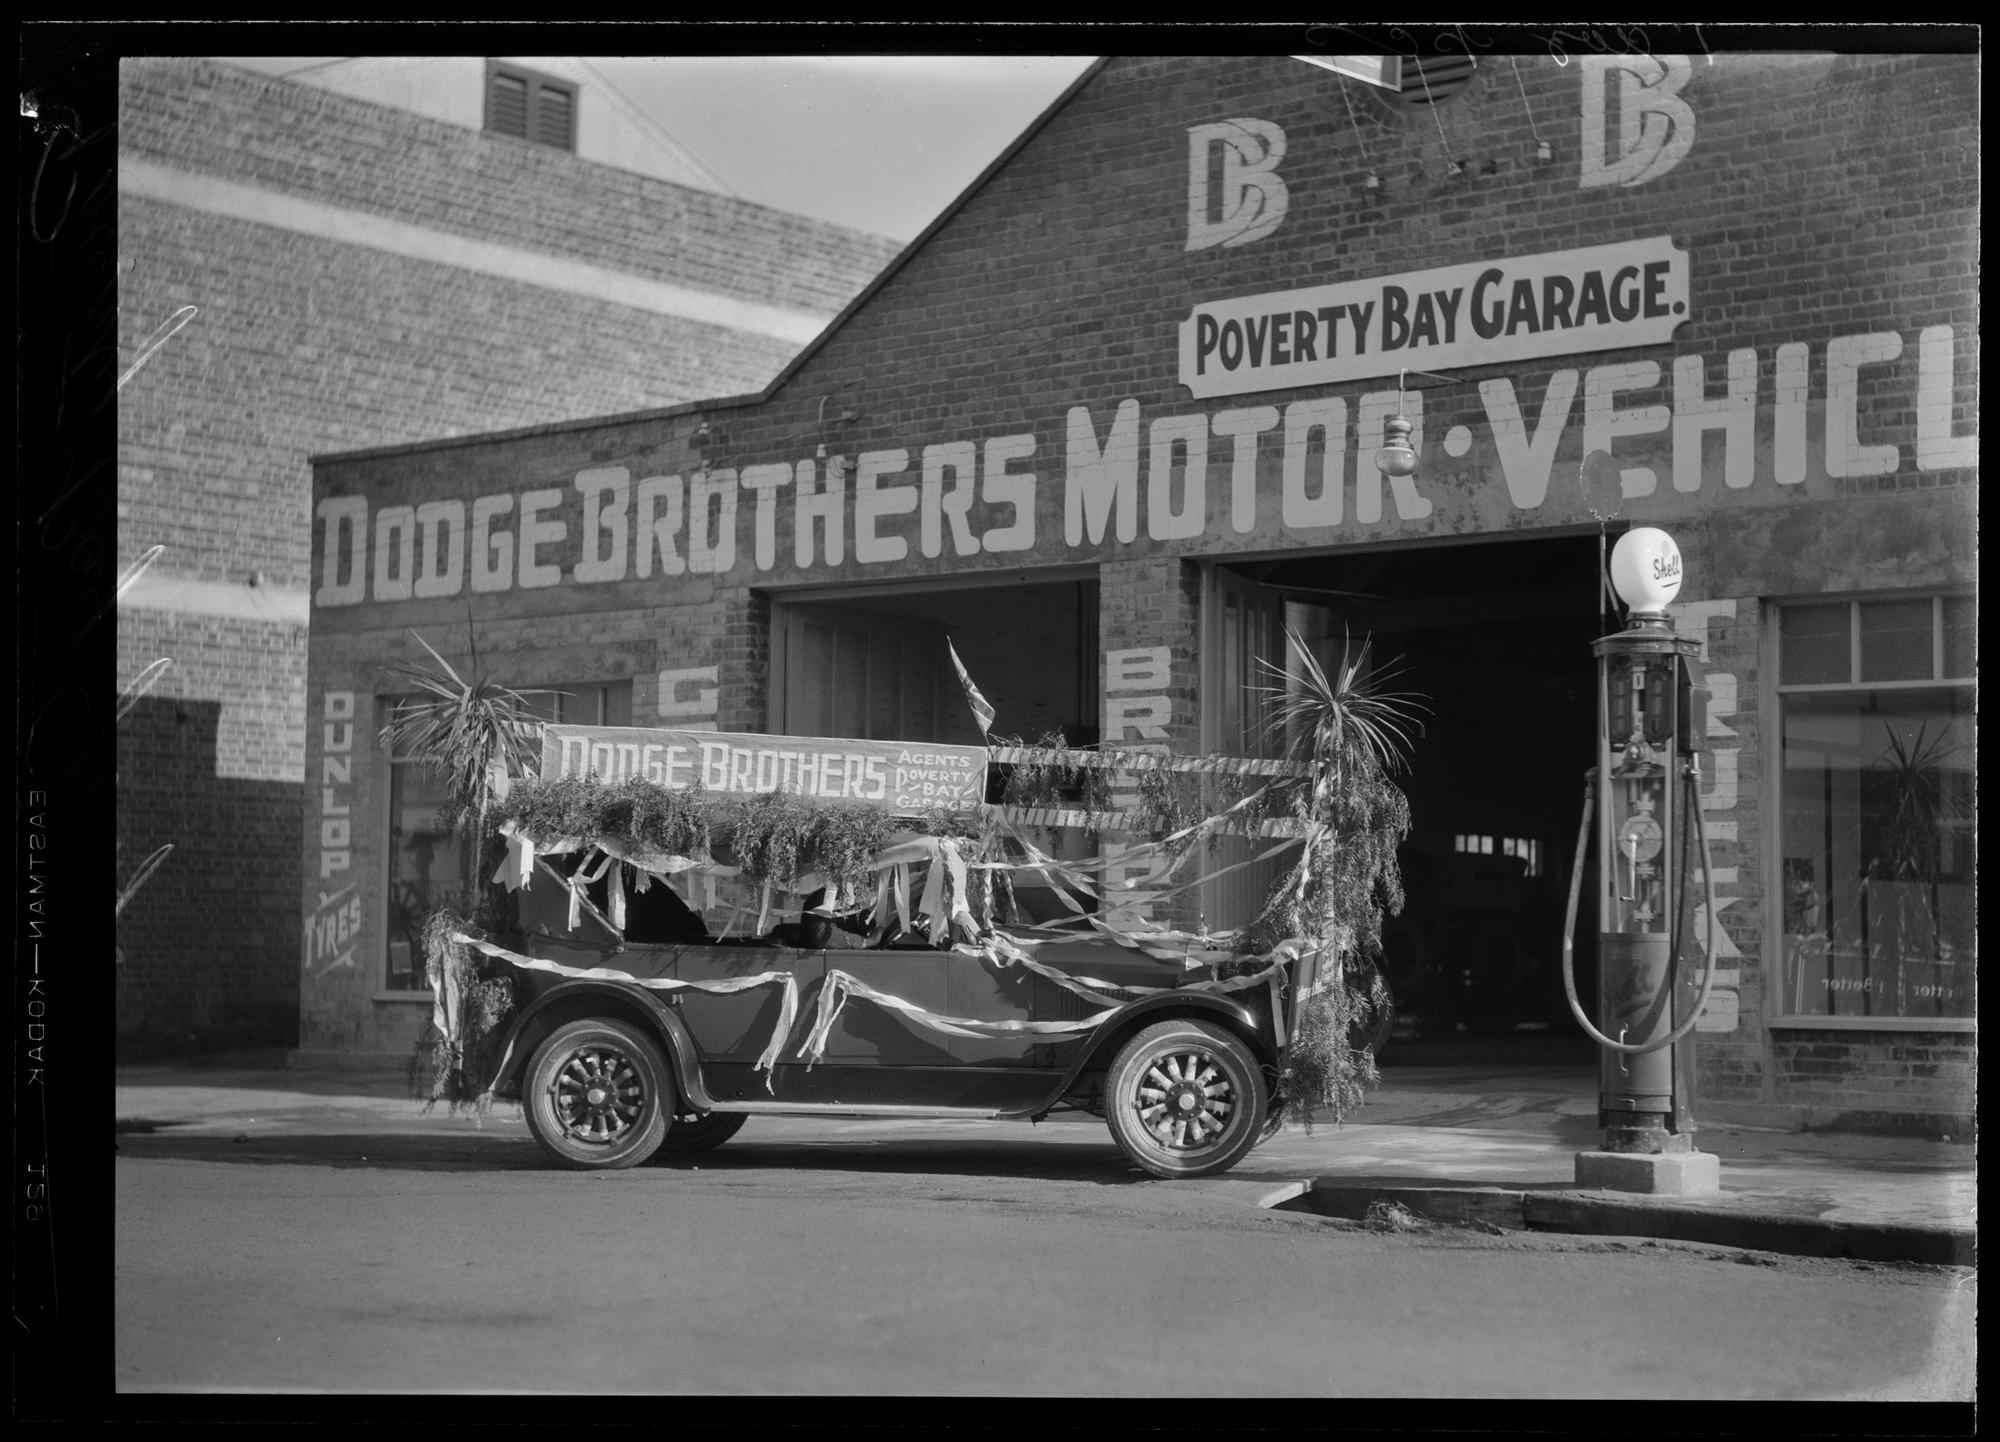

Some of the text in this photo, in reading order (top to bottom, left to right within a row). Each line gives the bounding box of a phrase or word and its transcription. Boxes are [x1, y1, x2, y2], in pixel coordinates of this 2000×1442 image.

[1196, 301, 1376, 375] POVERTY
[1381, 281, 1464, 352] BAY
[316, 488, 568, 607] DODGE
[574, 434, 1036, 584] BROTHERS
[1063, 390, 1432, 549] MOTOR
[1653, 553, 1680, 580] Shell
[320, 692, 355, 878] DUNLOP
[558, 735, 887, 800] DODGE BROTHERS
[895, 767, 973, 792] POVERTY
[897, 749, 971, 768] AGENTS
[922, 782, 963, 798] BAY
[304, 895, 361, 968] TYRES
